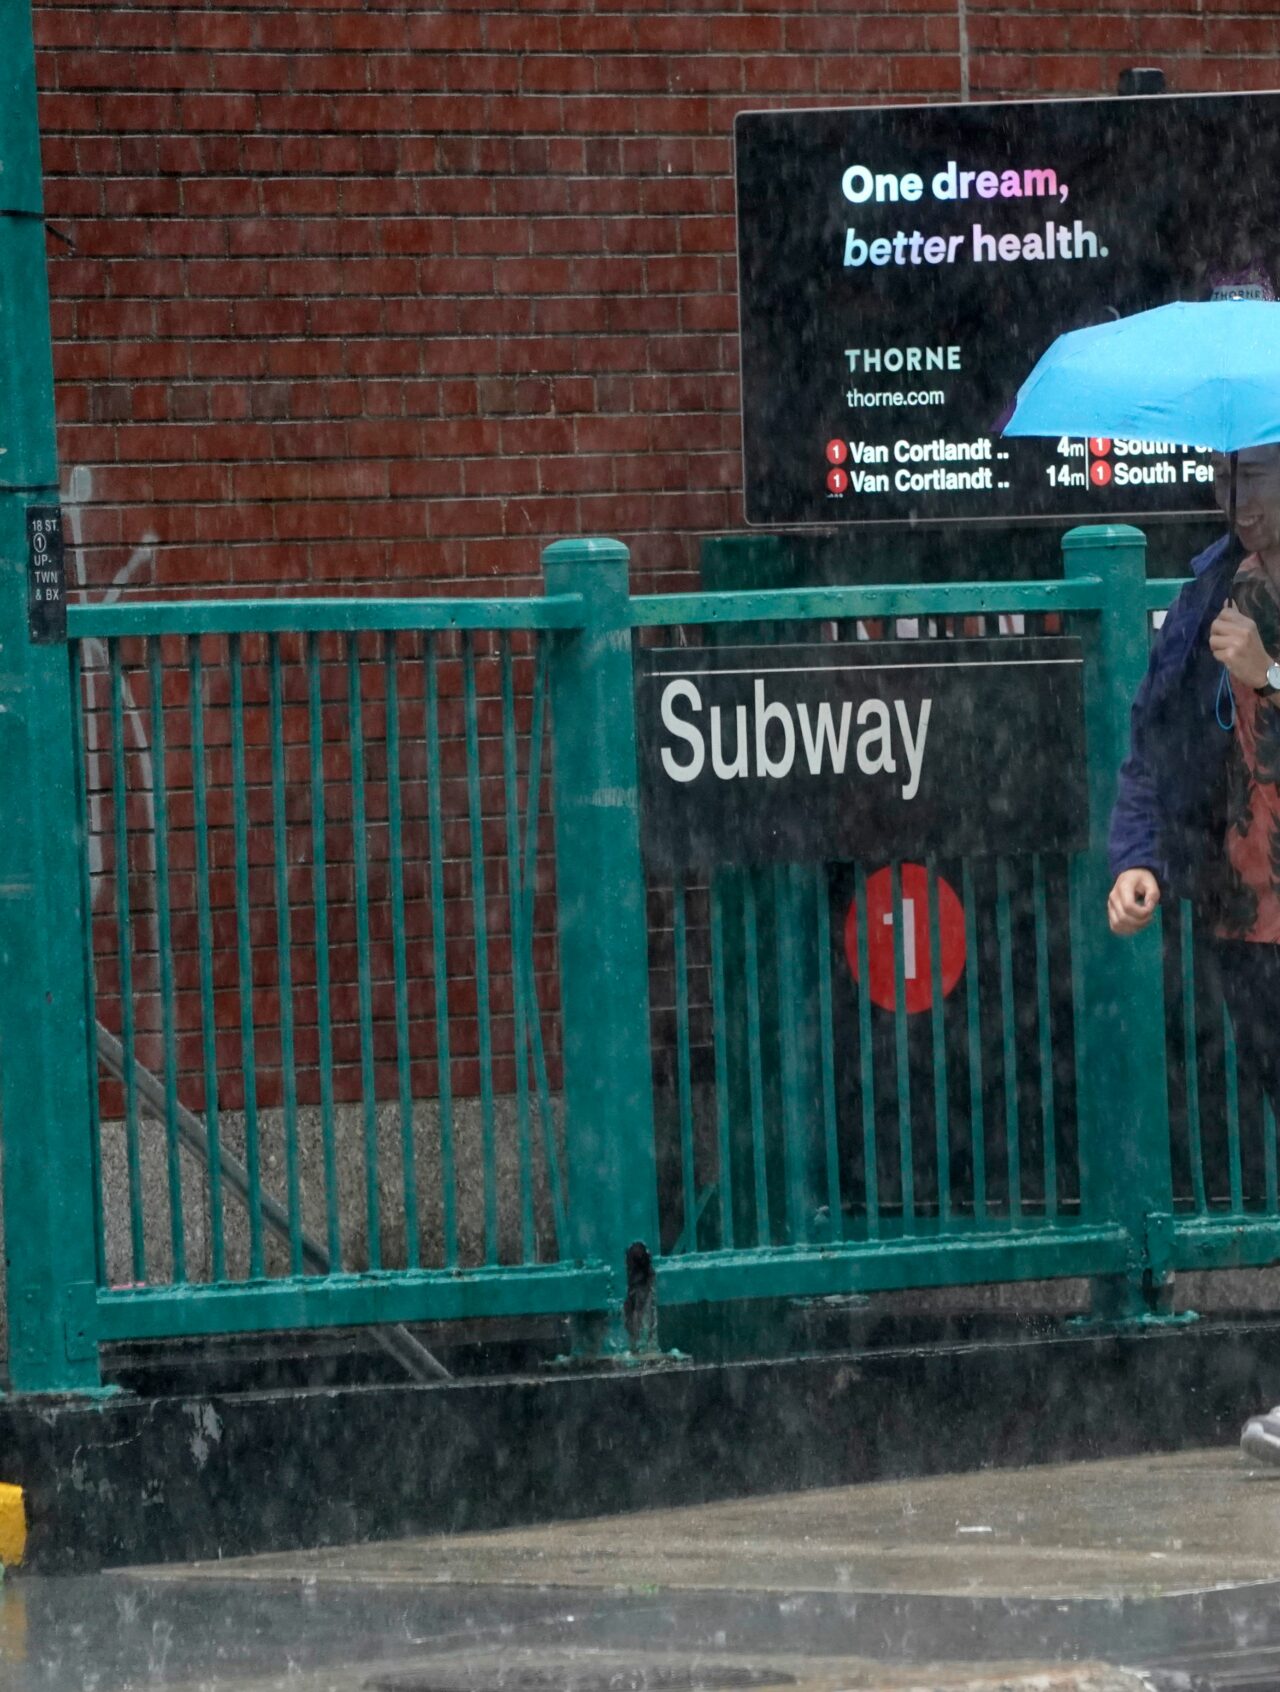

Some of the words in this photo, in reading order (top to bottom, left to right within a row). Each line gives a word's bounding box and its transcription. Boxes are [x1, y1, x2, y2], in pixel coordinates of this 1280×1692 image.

[842, 165, 923, 203] One
[932, 161, 1069, 203] dream,
[843, 228, 964, 266] better
[973, 220, 1109, 262] health.
[844, 346, 961, 373] THORNE
[846, 389, 945, 407] thorne.com
[849, 441, 888, 463] Van
[894, 438, 991, 462] Cortlandt
[1057, 436, 1085, 457] 4m
[850, 470, 889, 492] Van
[895, 467, 993, 490] Cortlandt
[1045, 464, 1085, 487] 14m
[1114, 461, 1177, 485] South
[32, 520, 42, 532] 18
[45, 519, 59, 532] ST.
[34, 554, 52, 566] UP-
[35, 571, 58, 583] TWN
[36, 588, 42, 600] &
[46, 588, 59, 600] BX
[661, 679, 932, 799] Subway
